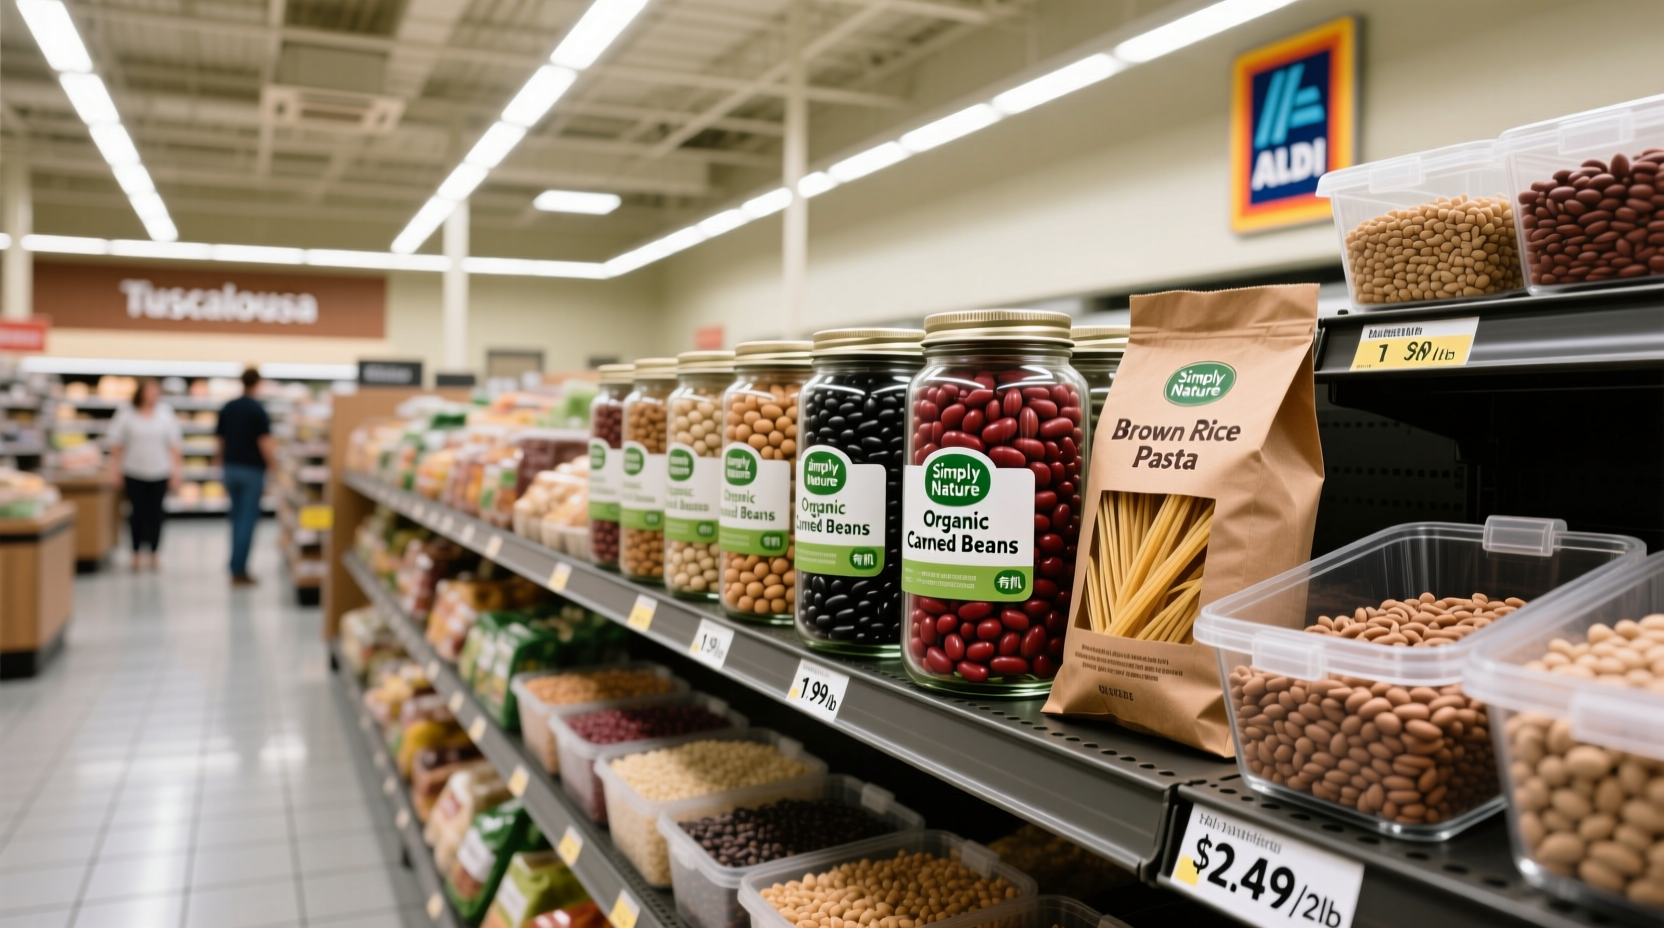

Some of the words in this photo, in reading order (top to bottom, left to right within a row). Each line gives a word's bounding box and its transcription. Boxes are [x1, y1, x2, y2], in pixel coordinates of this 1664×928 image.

[1251, 137, 1327, 191] ALDI
[1178, 369, 1227, 386] Simply
[1171, 383, 1221, 397] Nature
[1111, 418, 1185, 441] Brown
[1188, 419, 1242, 442] Rice
[1132, 445, 1199, 470] Pasta
[932, 462, 981, 484] Simply
[931, 480, 981, 497] Nature
[826, 518, 870, 536] Beans
[923, 509, 989, 534] Organic
[961, 534, 1019, 555] Beans
[1193, 834, 1341, 928] $2.49/2lb
